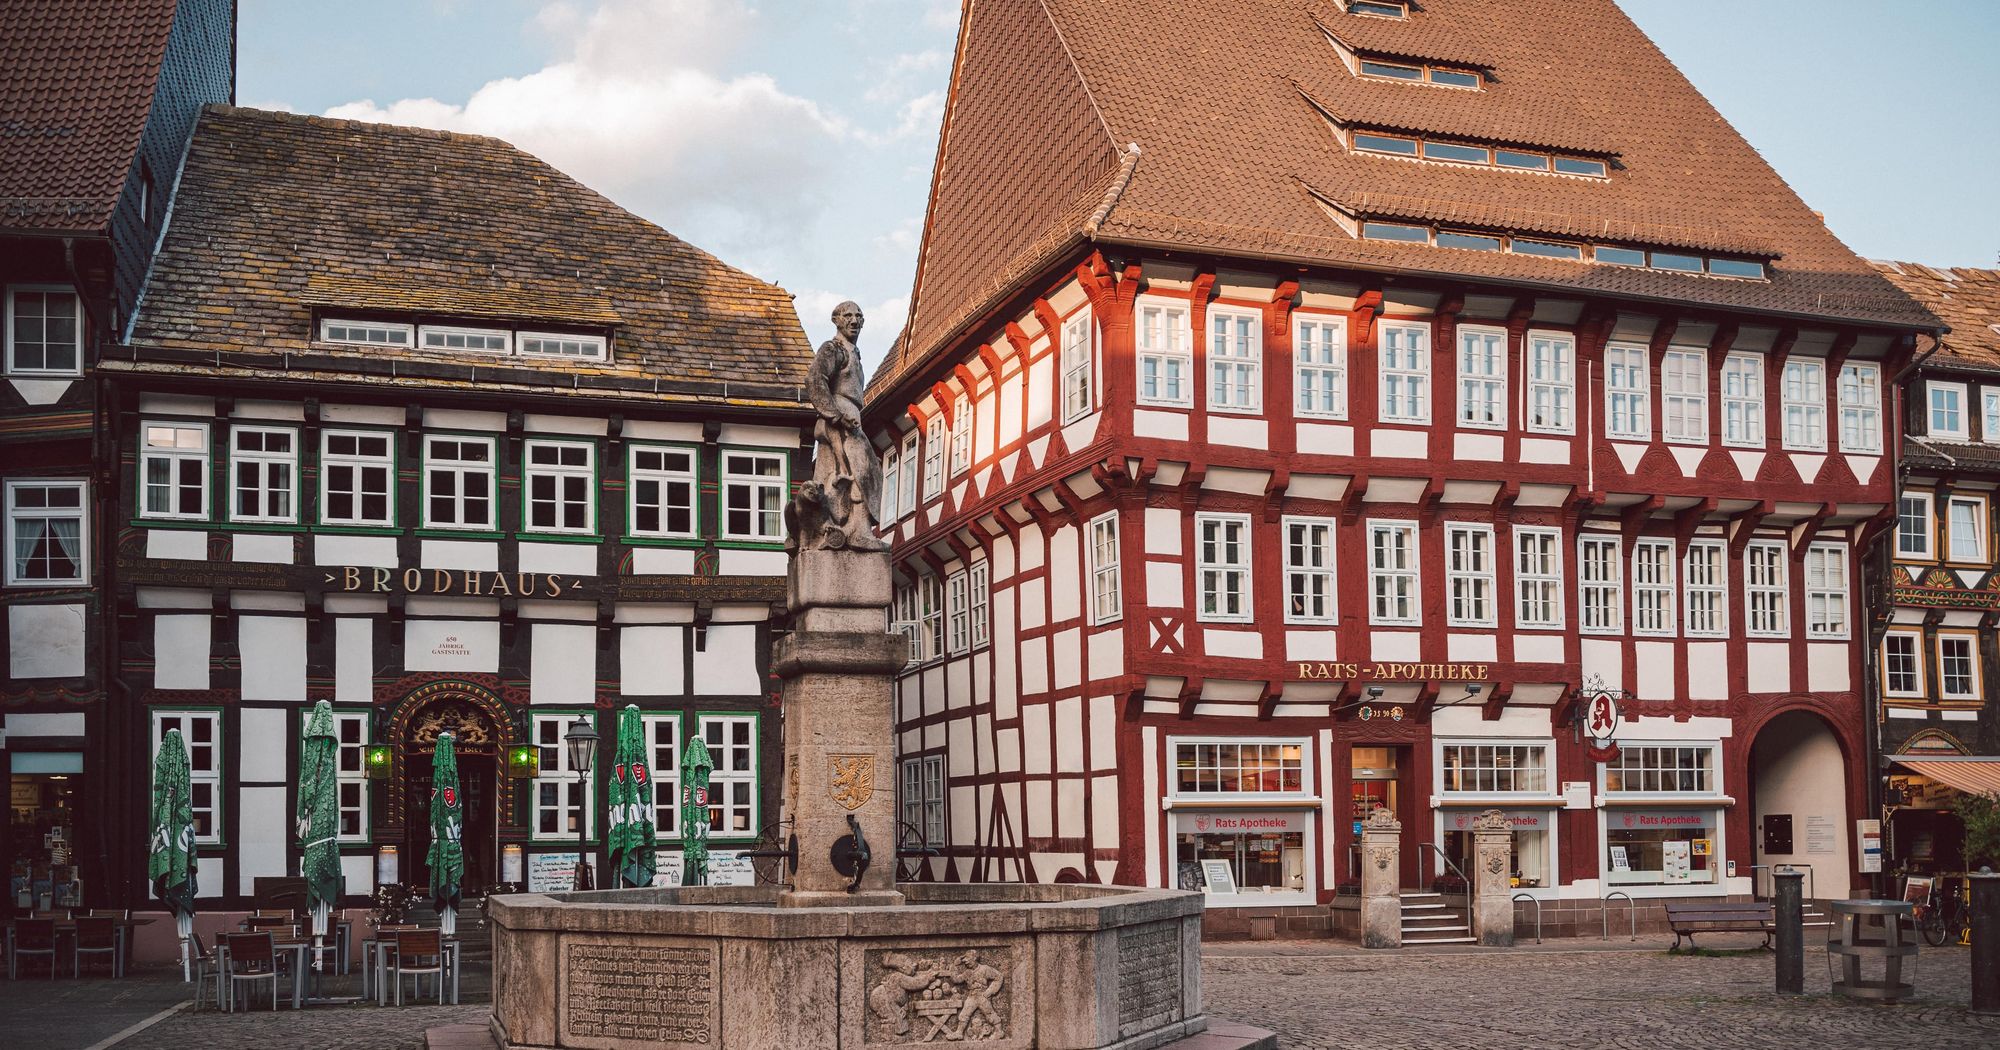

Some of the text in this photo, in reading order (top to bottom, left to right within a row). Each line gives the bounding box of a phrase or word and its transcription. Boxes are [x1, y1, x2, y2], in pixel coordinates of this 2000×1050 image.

[344, 566, 561, 597] BRODHAUS
[1215, 818, 1287, 829] Rats Apotheke
[1640, 815, 1701, 826] Rats Apotheke
